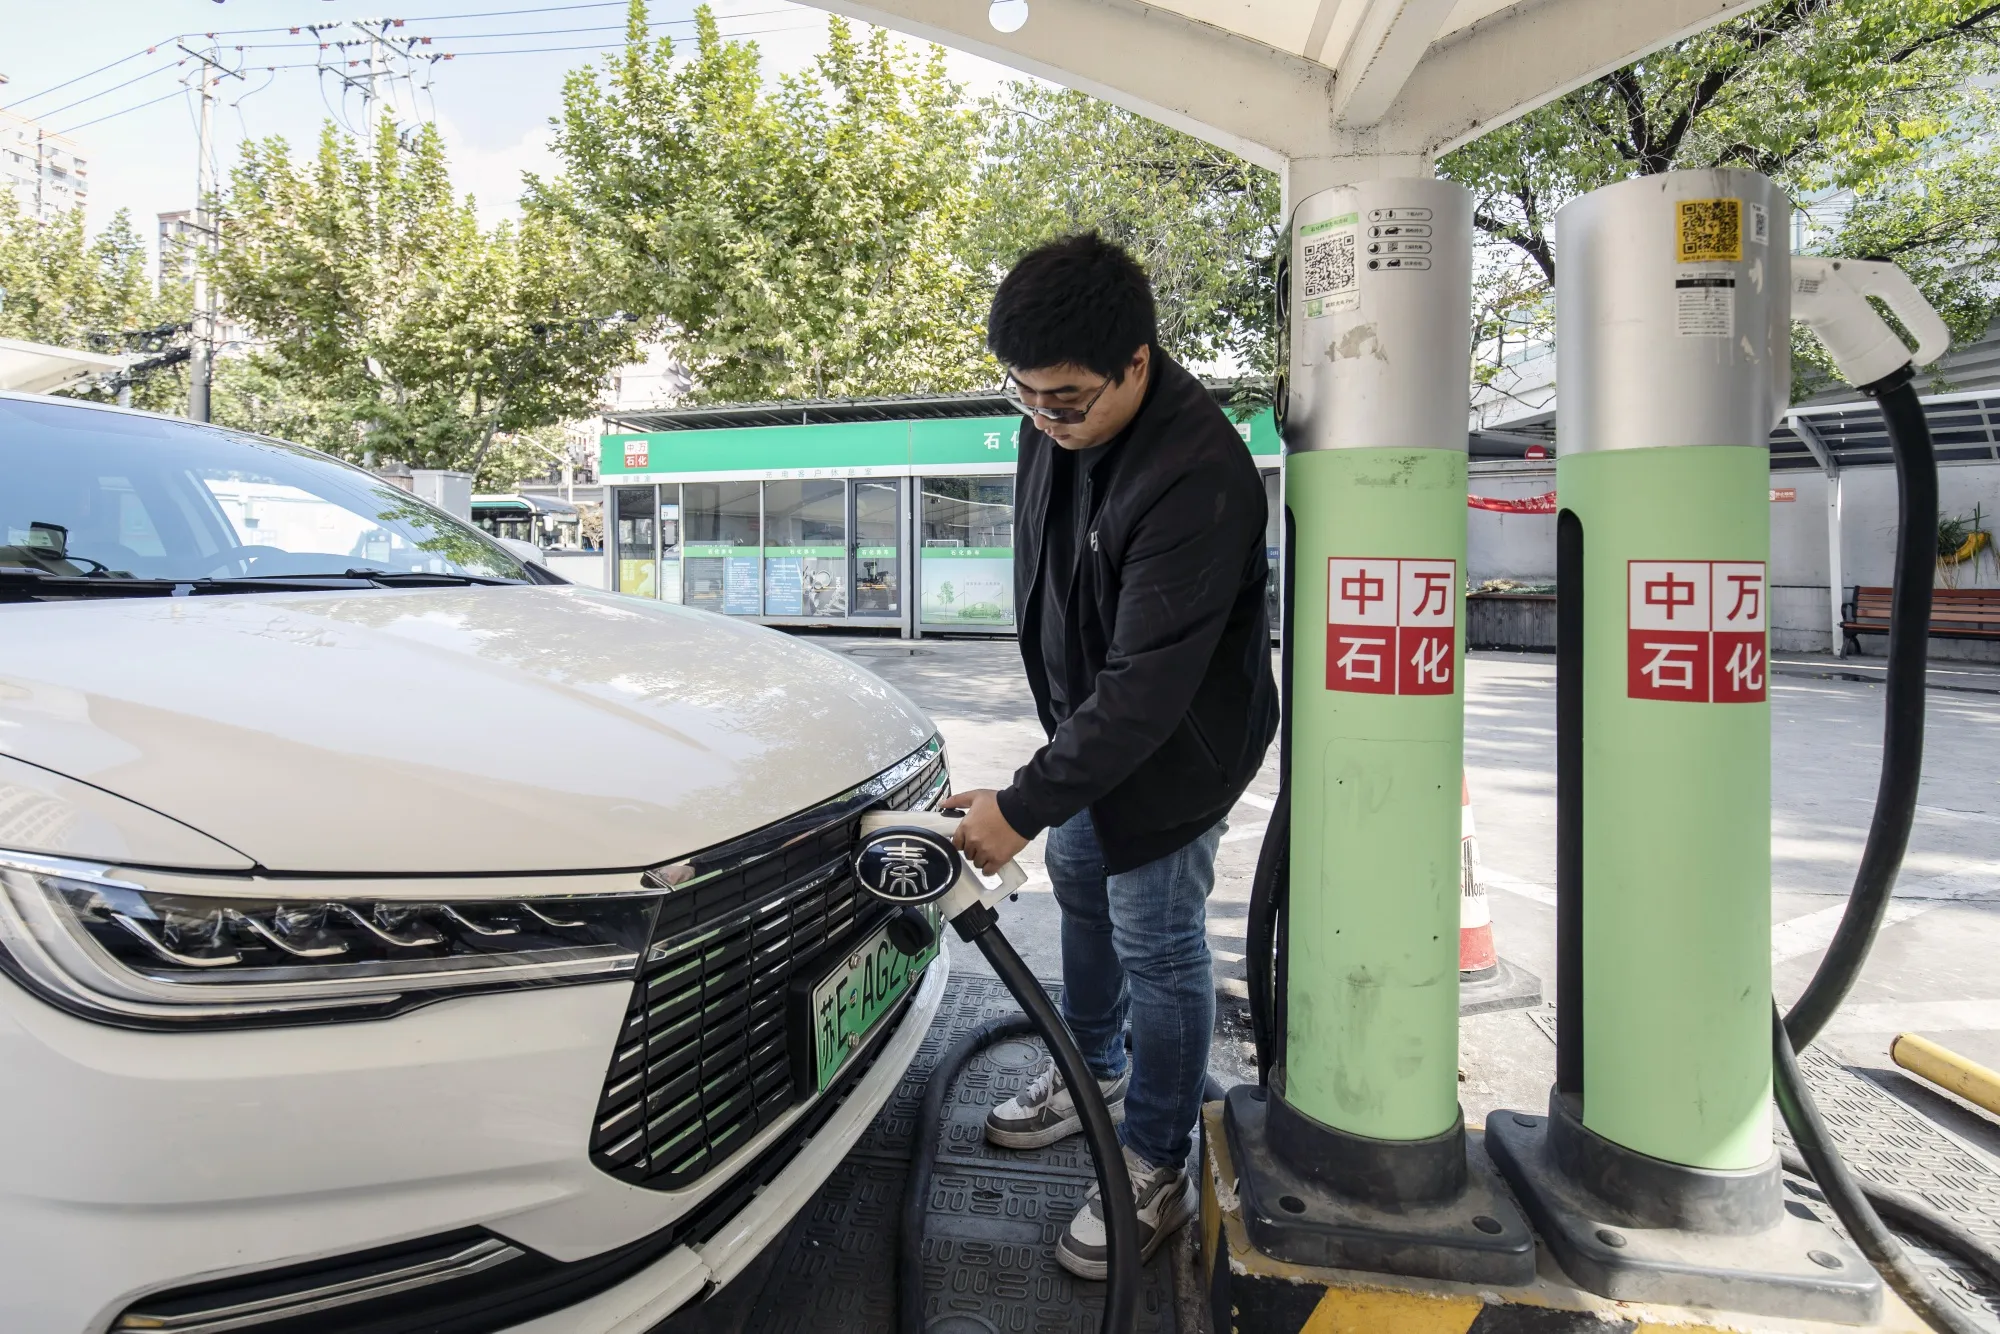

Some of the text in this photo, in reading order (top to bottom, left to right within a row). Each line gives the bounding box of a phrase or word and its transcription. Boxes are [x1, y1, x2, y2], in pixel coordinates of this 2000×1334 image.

[626, 455, 648, 466] 石化
[1341, 568, 1451, 617] 中万
[1645, 571, 1762, 621] 中万
[1336, 636, 1450, 685] 石化
[1640, 642, 1763, 692] 石化
